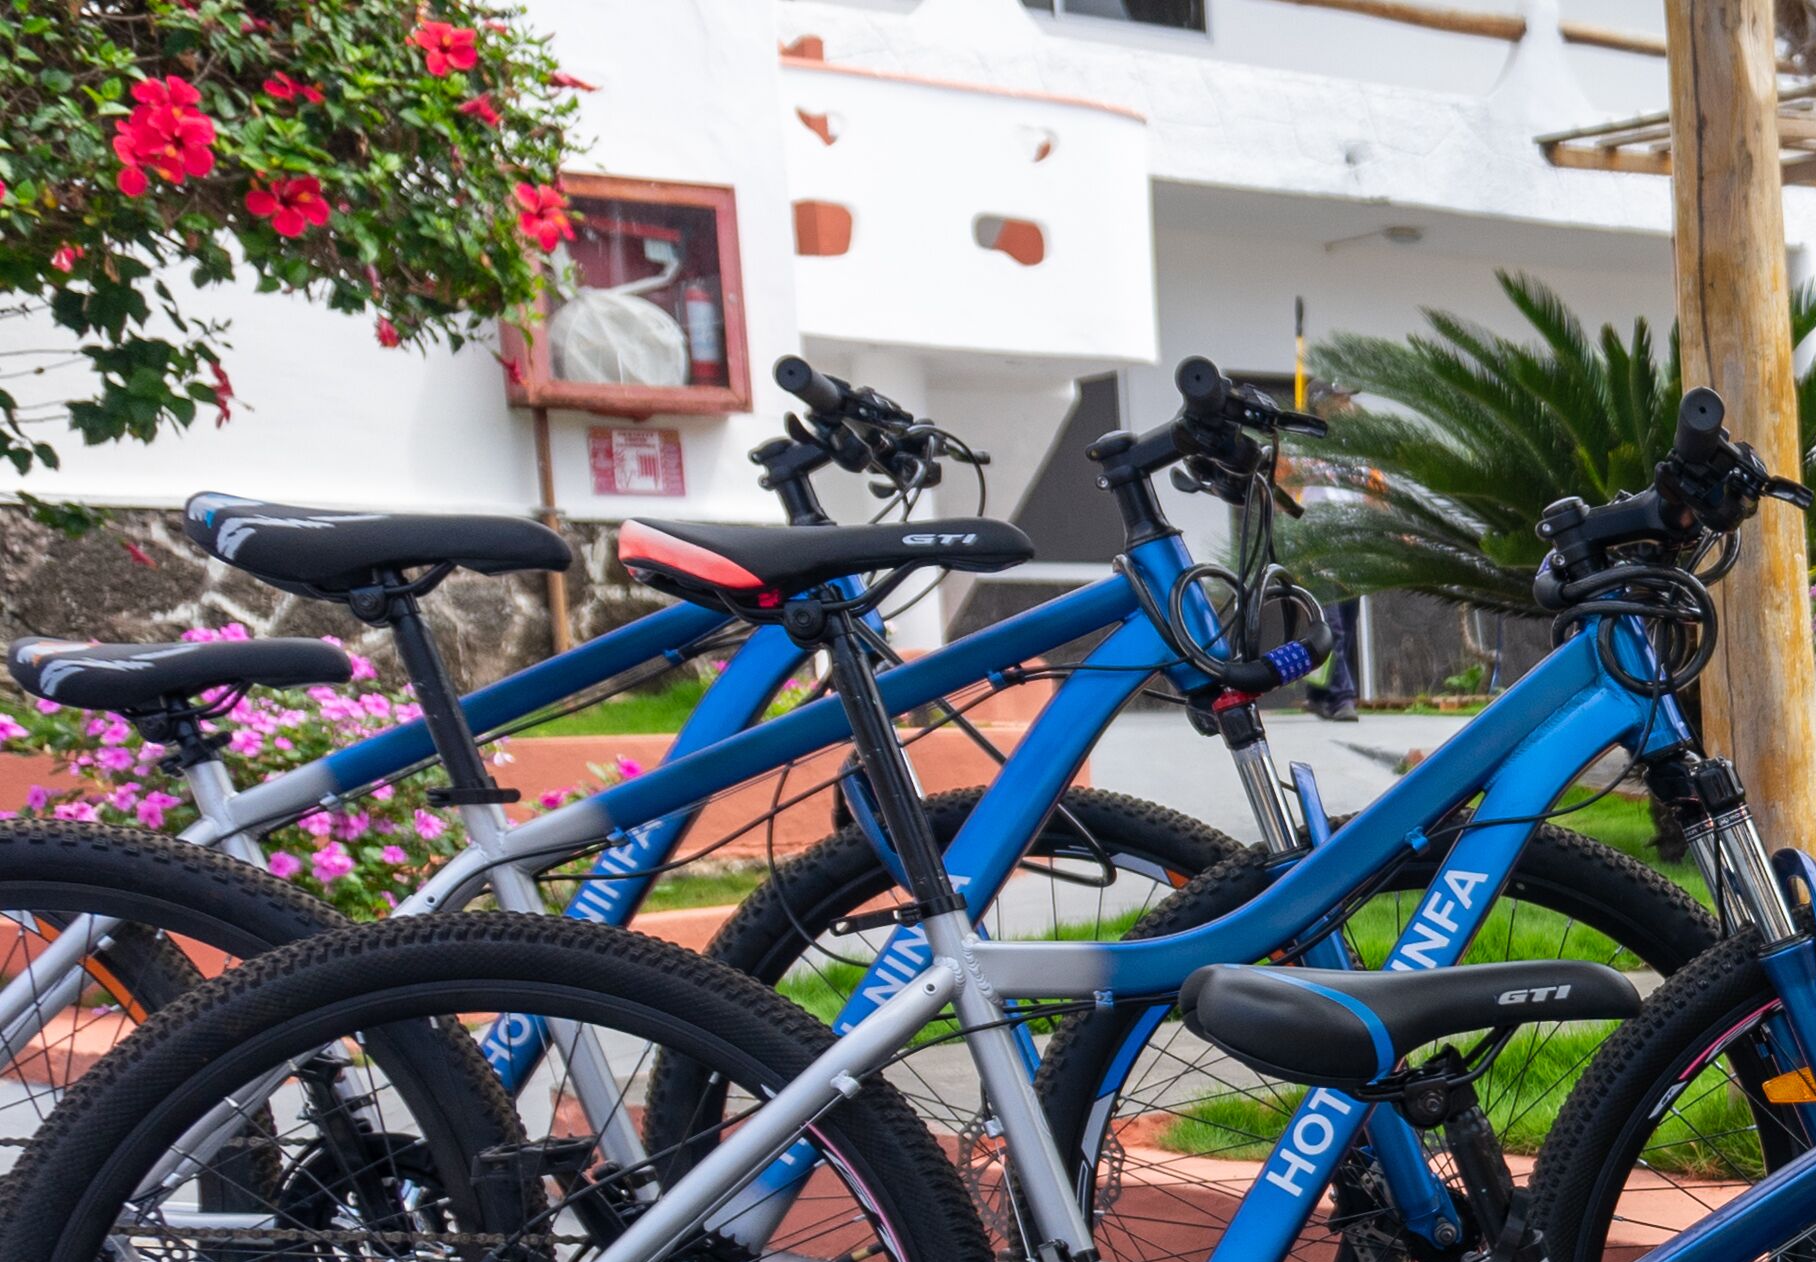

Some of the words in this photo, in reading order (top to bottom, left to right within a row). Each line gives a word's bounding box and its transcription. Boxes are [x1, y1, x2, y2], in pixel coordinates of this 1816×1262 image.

[902, 533, 976, 544] GTI
[1498, 985, 1571, 1005] GTI
[1266, 1088, 1351, 1197] HOT
